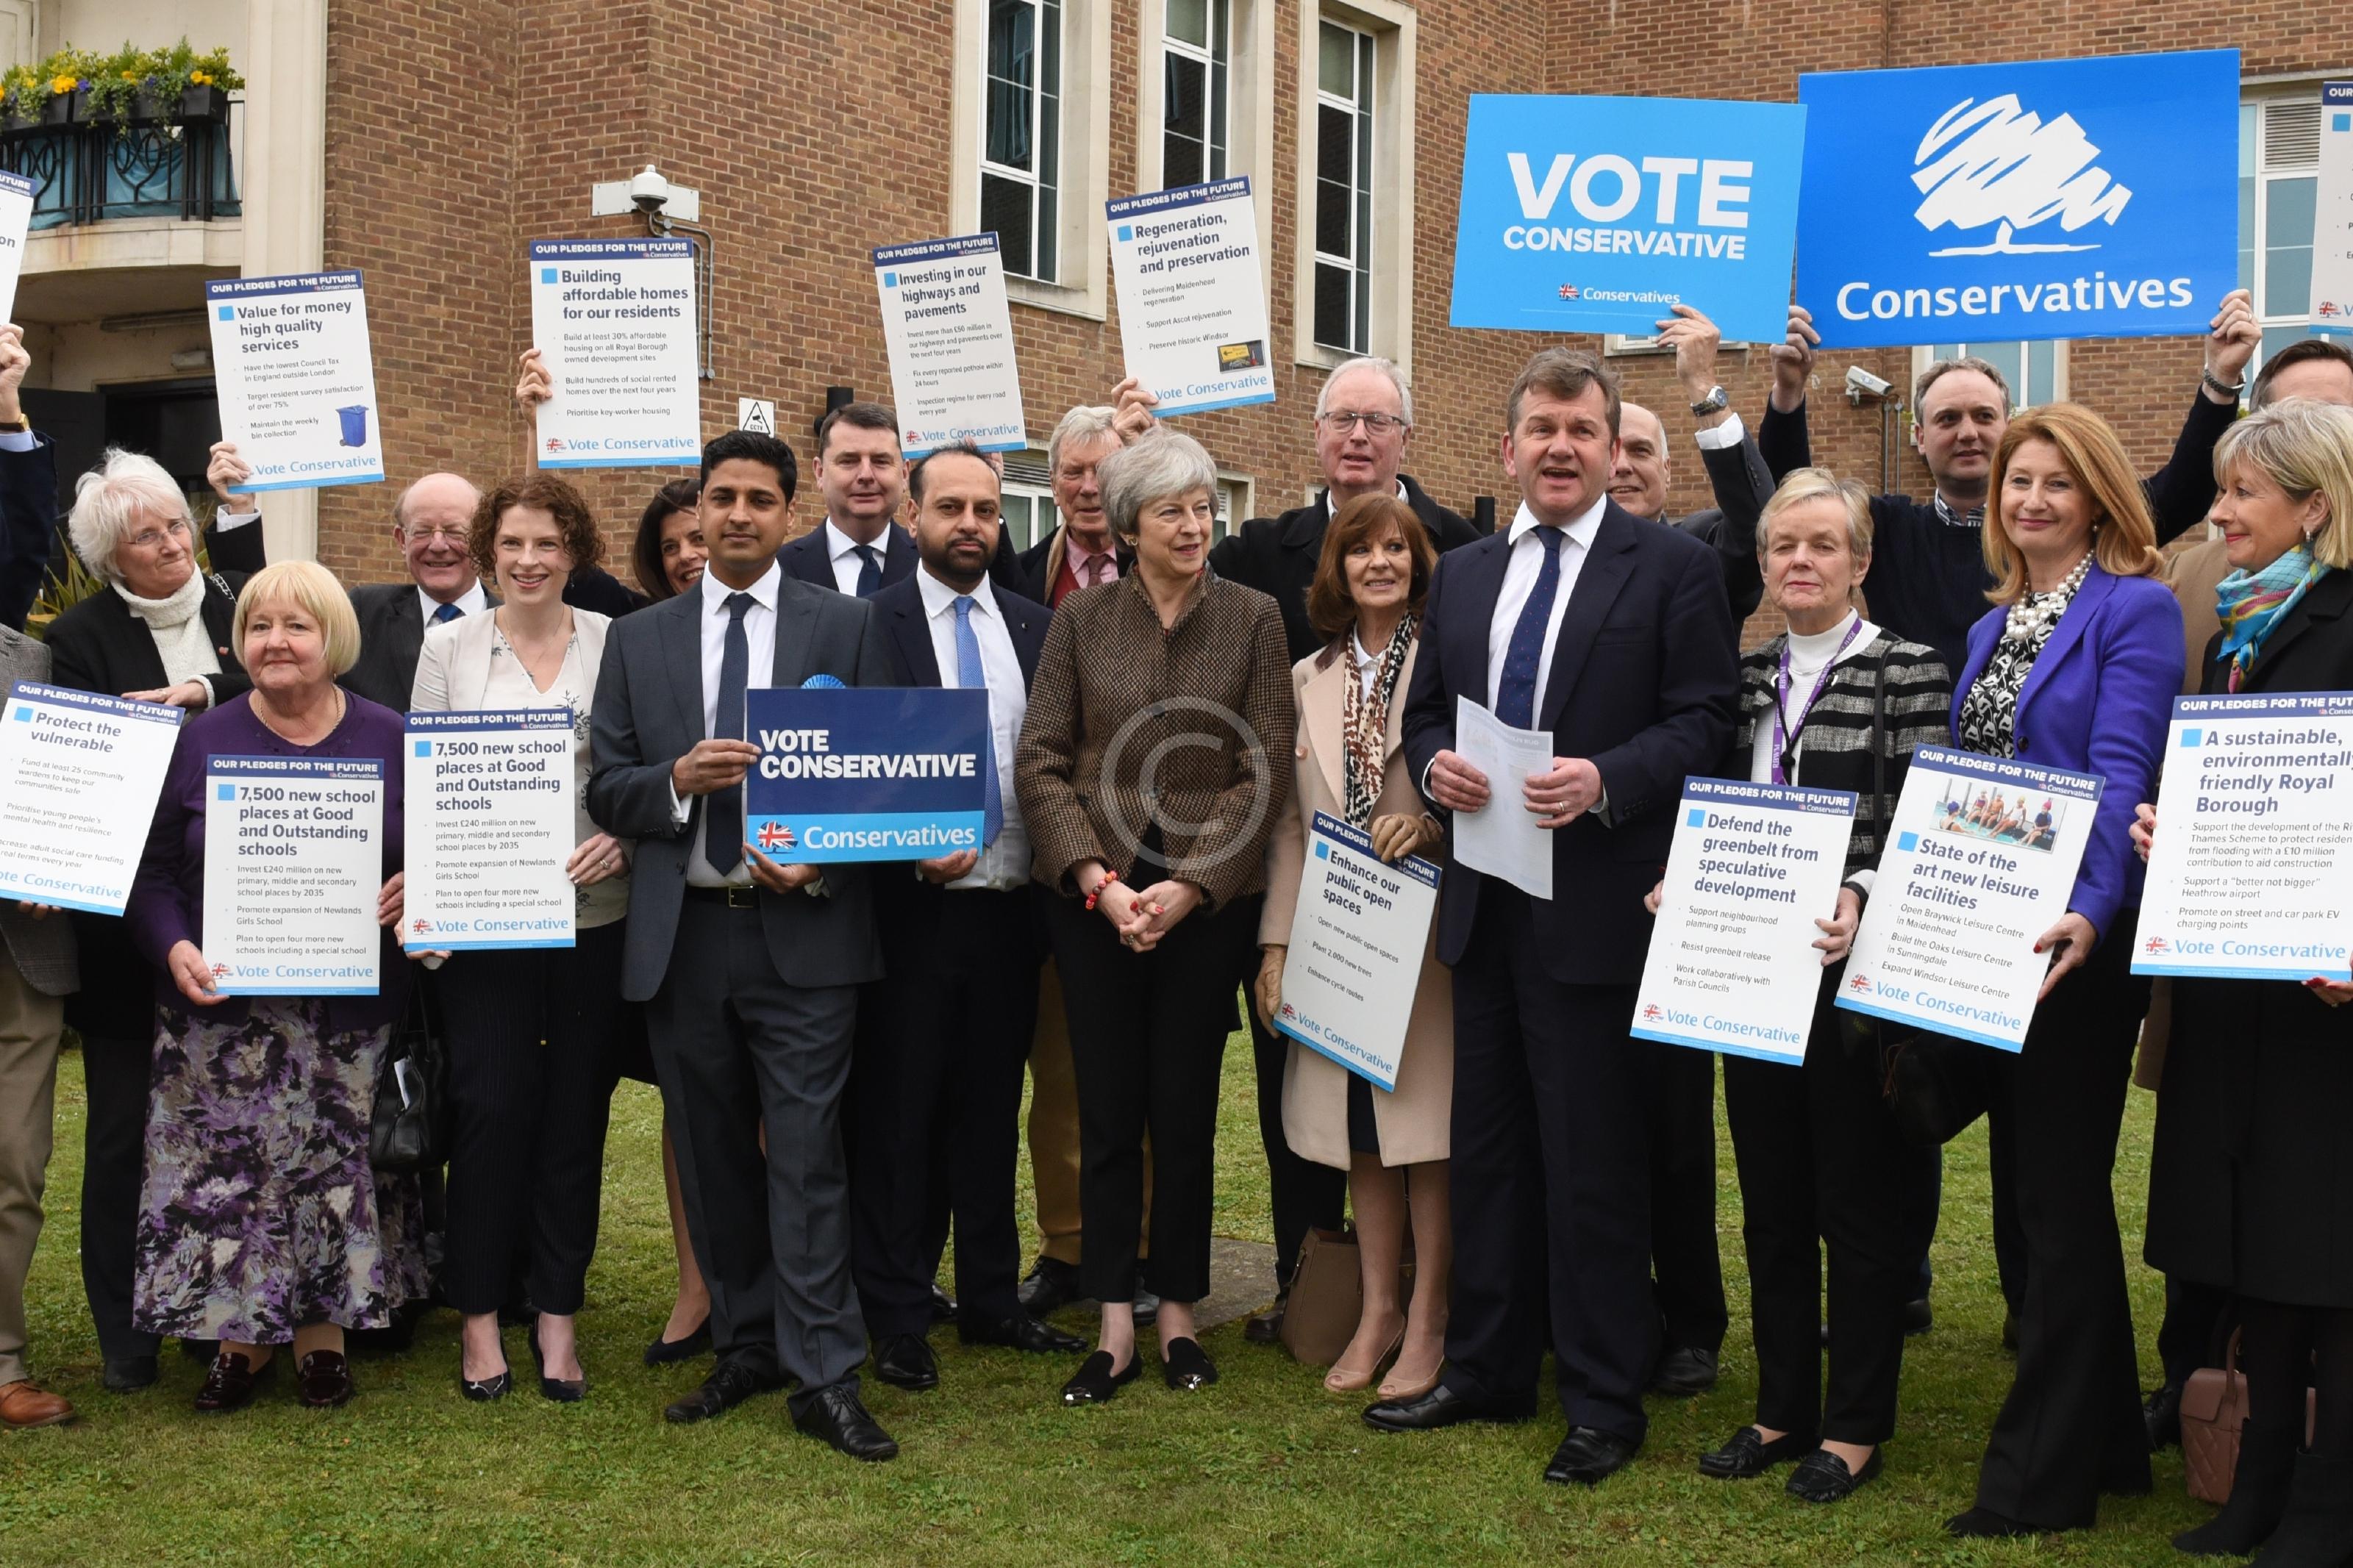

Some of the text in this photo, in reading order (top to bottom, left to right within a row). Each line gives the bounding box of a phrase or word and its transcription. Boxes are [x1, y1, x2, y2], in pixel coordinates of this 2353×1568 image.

[2329, 87, 2353, 97] OUR
[0, 173, 31, 190] UTURE
[1507, 152, 1754, 229] VOTE
[1135, 213, 1227, 238] Regeneration,
[535, 242, 687, 253] OUR PLEDGES FOR THE FUTURE
[1138, 232, 1219, 257] rejuvenation
[1503, 225, 1746, 260] CONSERVATIVE
[1140, 246, 1249, 273] and preservation
[562, 269, 621, 285] Building
[899, 266, 986, 285] Investing in our
[563, 287, 688, 301] affordable homes
[901, 282, 979, 304] highways and
[1582, 287, 1681, 304] Conservatives
[1836, 271, 2193, 321] Conservatives
[237, 301, 351, 318] Value for money
[563, 304, 680, 319] for our residents
[904, 302, 966, 322] pavements
[240, 318, 322, 337] high quality
[242, 338, 299, 353] services
[1149, 332, 1228, 350] Preserve historic Windsor
[1155, 375, 1267, 400] Vote Conservative
[642, 407, 670, 415] housing
[922, 423, 1018, 441] Vote Conservative
[568, 436, 693, 450] Vote Conservative
[255, 456, 376, 475] Vote Conservative
[1779, 666, 1787, 690] RBWM
[35, 712, 121, 737] Protect the
[31, 731, 113, 753] vulnerable
[759, 729, 829, 753] VOTE
[2205, 728, 2342, 746] A sustainable,
[435, 740, 565, 757] 7,500 new school
[1773, 744, 1781, 768] RBWM
[436, 758, 545, 777] places at Good
[760, 753, 976, 779] CONSERVATIVE
[436, 776, 560, 792] and Outstanding
[2199, 773, 2334, 794] friendly Royal
[240, 787, 375, 803] 7,500 new school
[436, 796, 492, 810] schools
[1689, 782, 1850, 806] OUR PLEDGES FOR THE FUTURE
[240, 805, 353, 822] places at Good
[1804, 804, 1849, 815] Conservatives
[2196, 796, 2278, 816] Borough
[239, 824, 368, 842] and Outstanding
[1707, 813, 1792, 837] Defend the
[804, 823, 976, 849] Conservatives
[238, 842, 297, 856] schools
[1702, 838, 1818, 862] greenbelt from
[1919, 838, 2016, 872] State of the
[1330, 850, 1400, 894] Enhance our
[1699, 859, 1786, 879] speculative
[24, 873, 122, 898] Conservative
[1326, 871, 1391, 910] public open
[1694, 876, 1796, 903] development
[1913, 864, 2038, 900] art new leisure
[1323, 889, 1361, 914] spaces
[1907, 881, 1977, 909] facilities
[2182, 888, 2260, 899] Heathrow airport
[436, 917, 568, 932] Vote Conservative
[1900, 903, 2024, 938] Open Braywick Leisure Centre
[2177, 919, 2248, 931] charging points
[1312, 940, 1327, 953] Plant
[1344, 959, 1357, 970] new
[1357, 965, 1371, 978] trees
[1681, 940, 1771, 962] Resist greenbelt release
[2175, 939, 2346, 959] Vote Conservative
[236, 965, 373, 977] Vote Conservative
[1877, 981, 1910, 1001] Vote
[1915, 992, 2021, 1030] Conservative
[1667, 1009, 1800, 1043] Vote Conservative
[1299, 1012, 1320, 1034] Vote
[1324, 1027, 1392, 1073] Conservative
